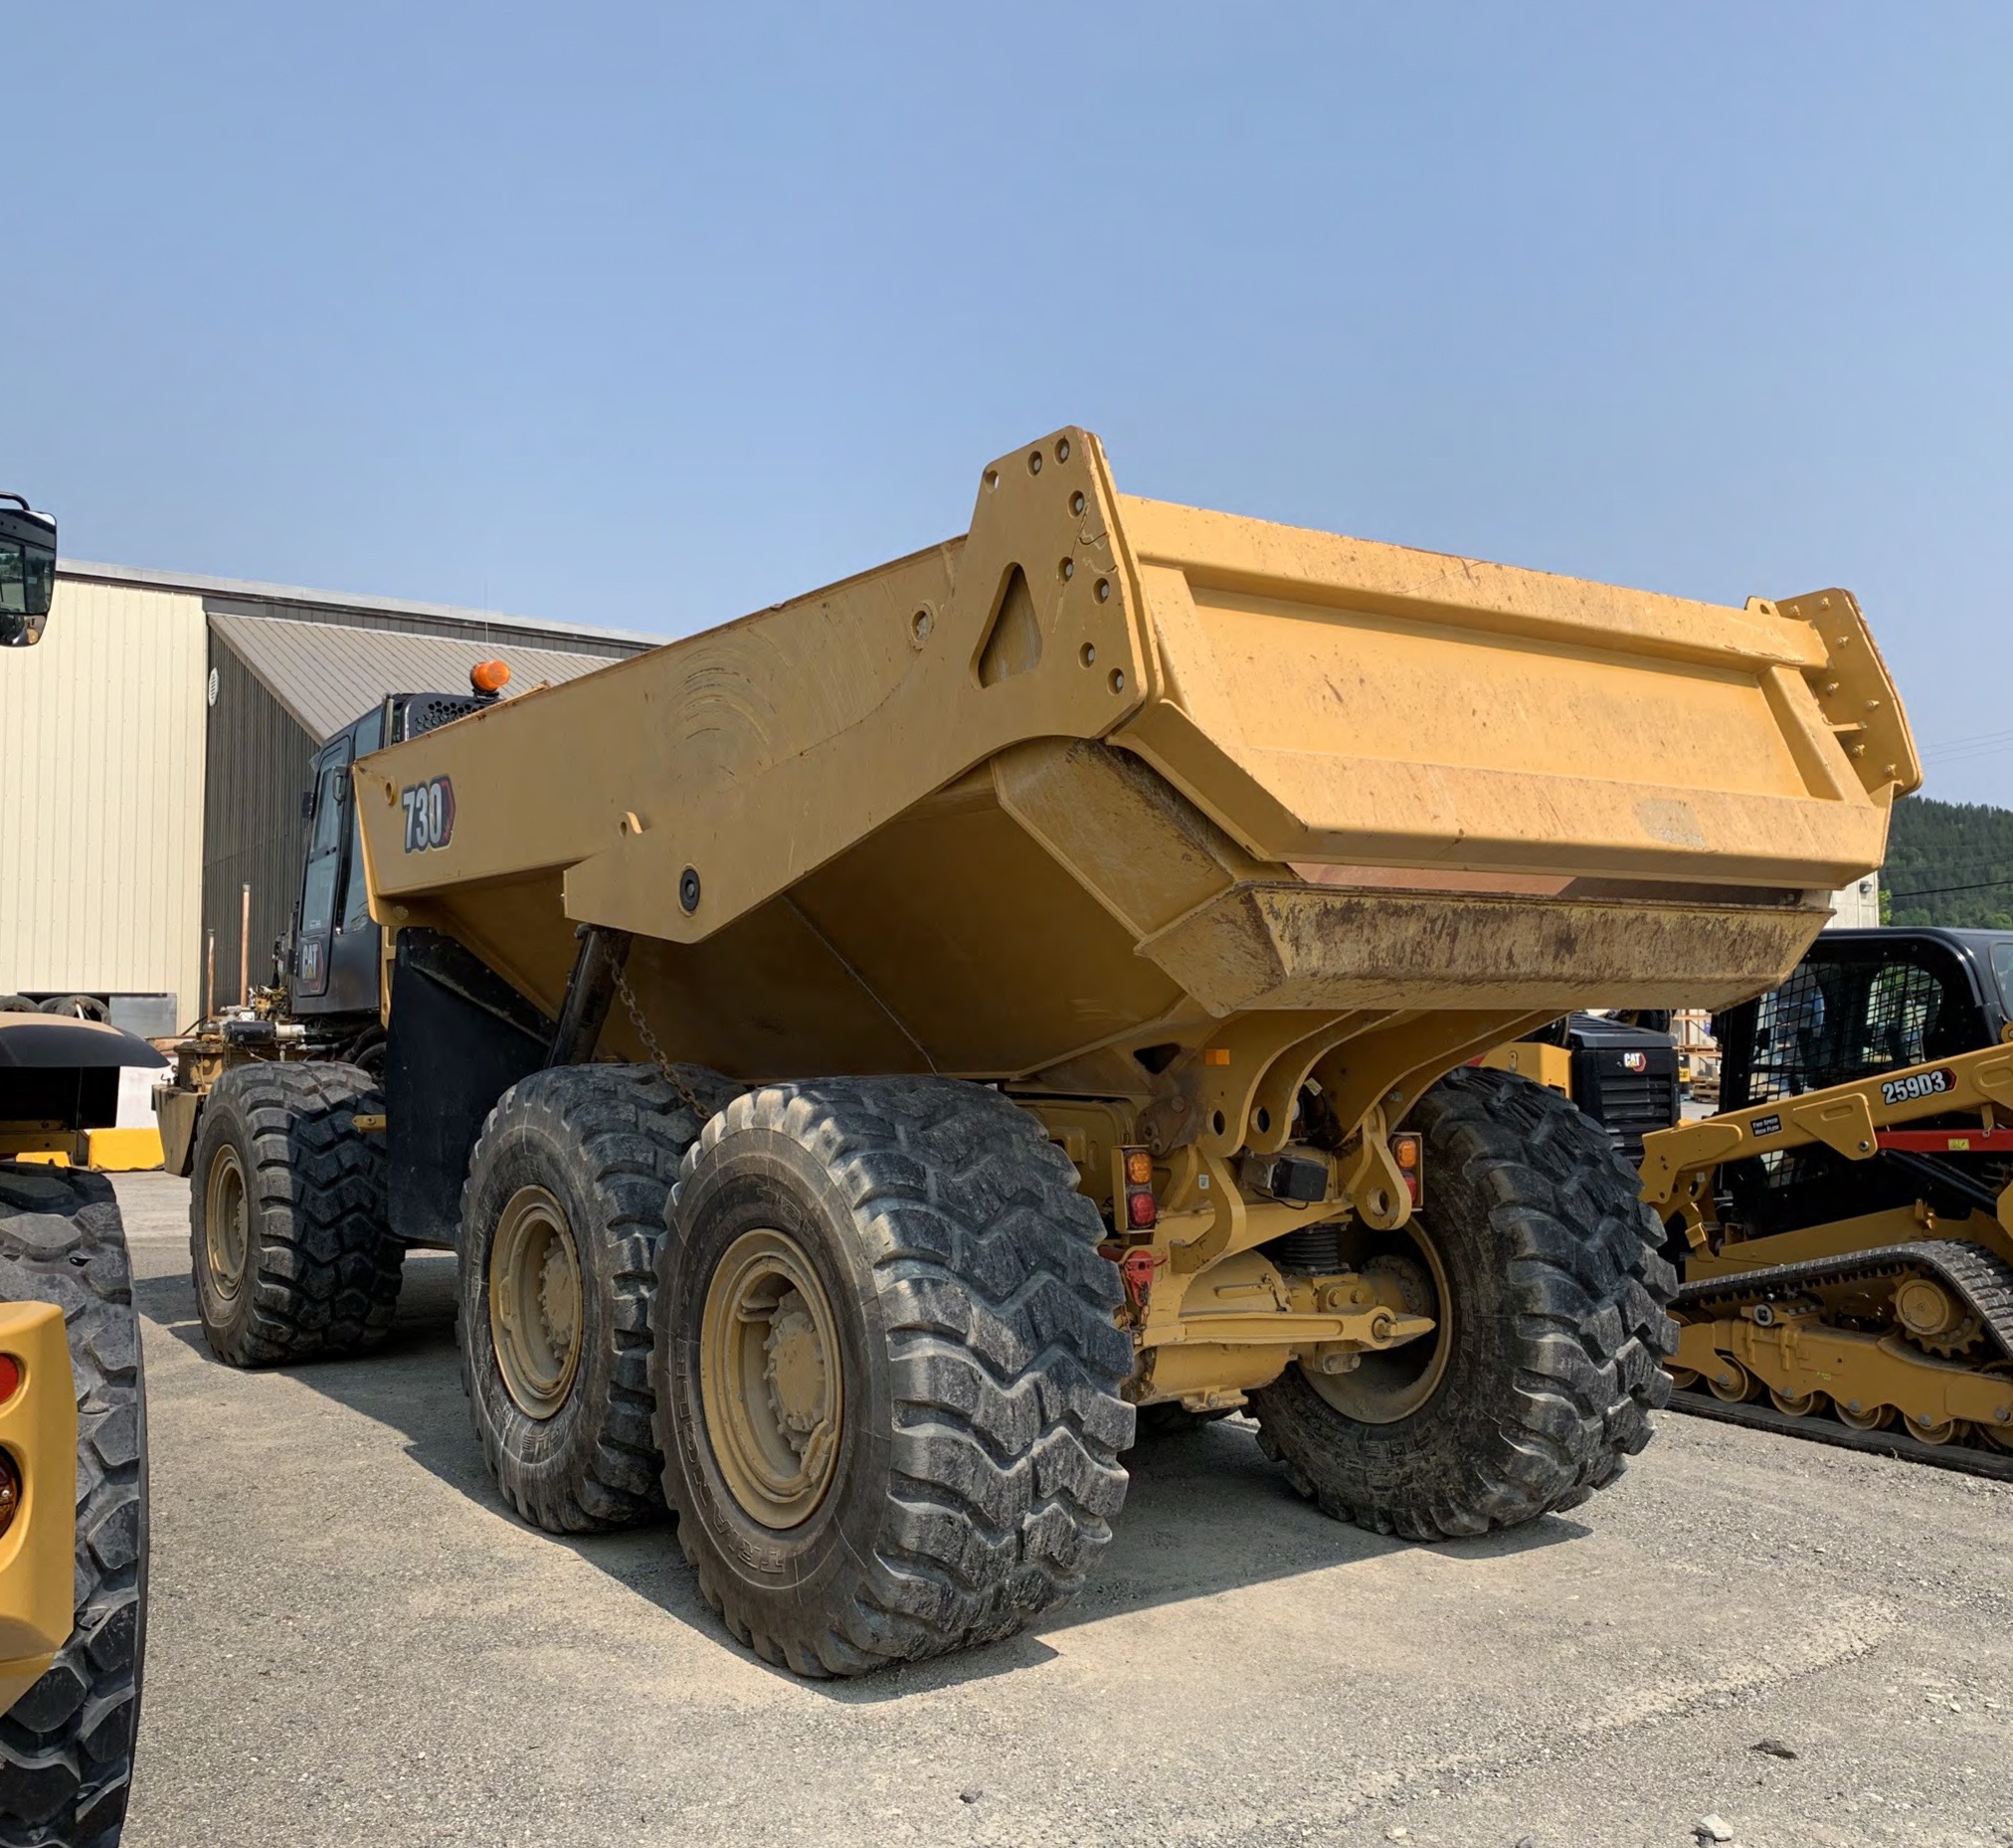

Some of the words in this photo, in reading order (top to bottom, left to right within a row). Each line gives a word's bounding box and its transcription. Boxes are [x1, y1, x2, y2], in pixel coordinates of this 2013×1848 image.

[402, 782, 444, 848] 730
[302, 943, 318, 981] CAT
[1624, 1052, 1640, 1067] CAT
[1882, 1070, 1946, 1105] 259D3
